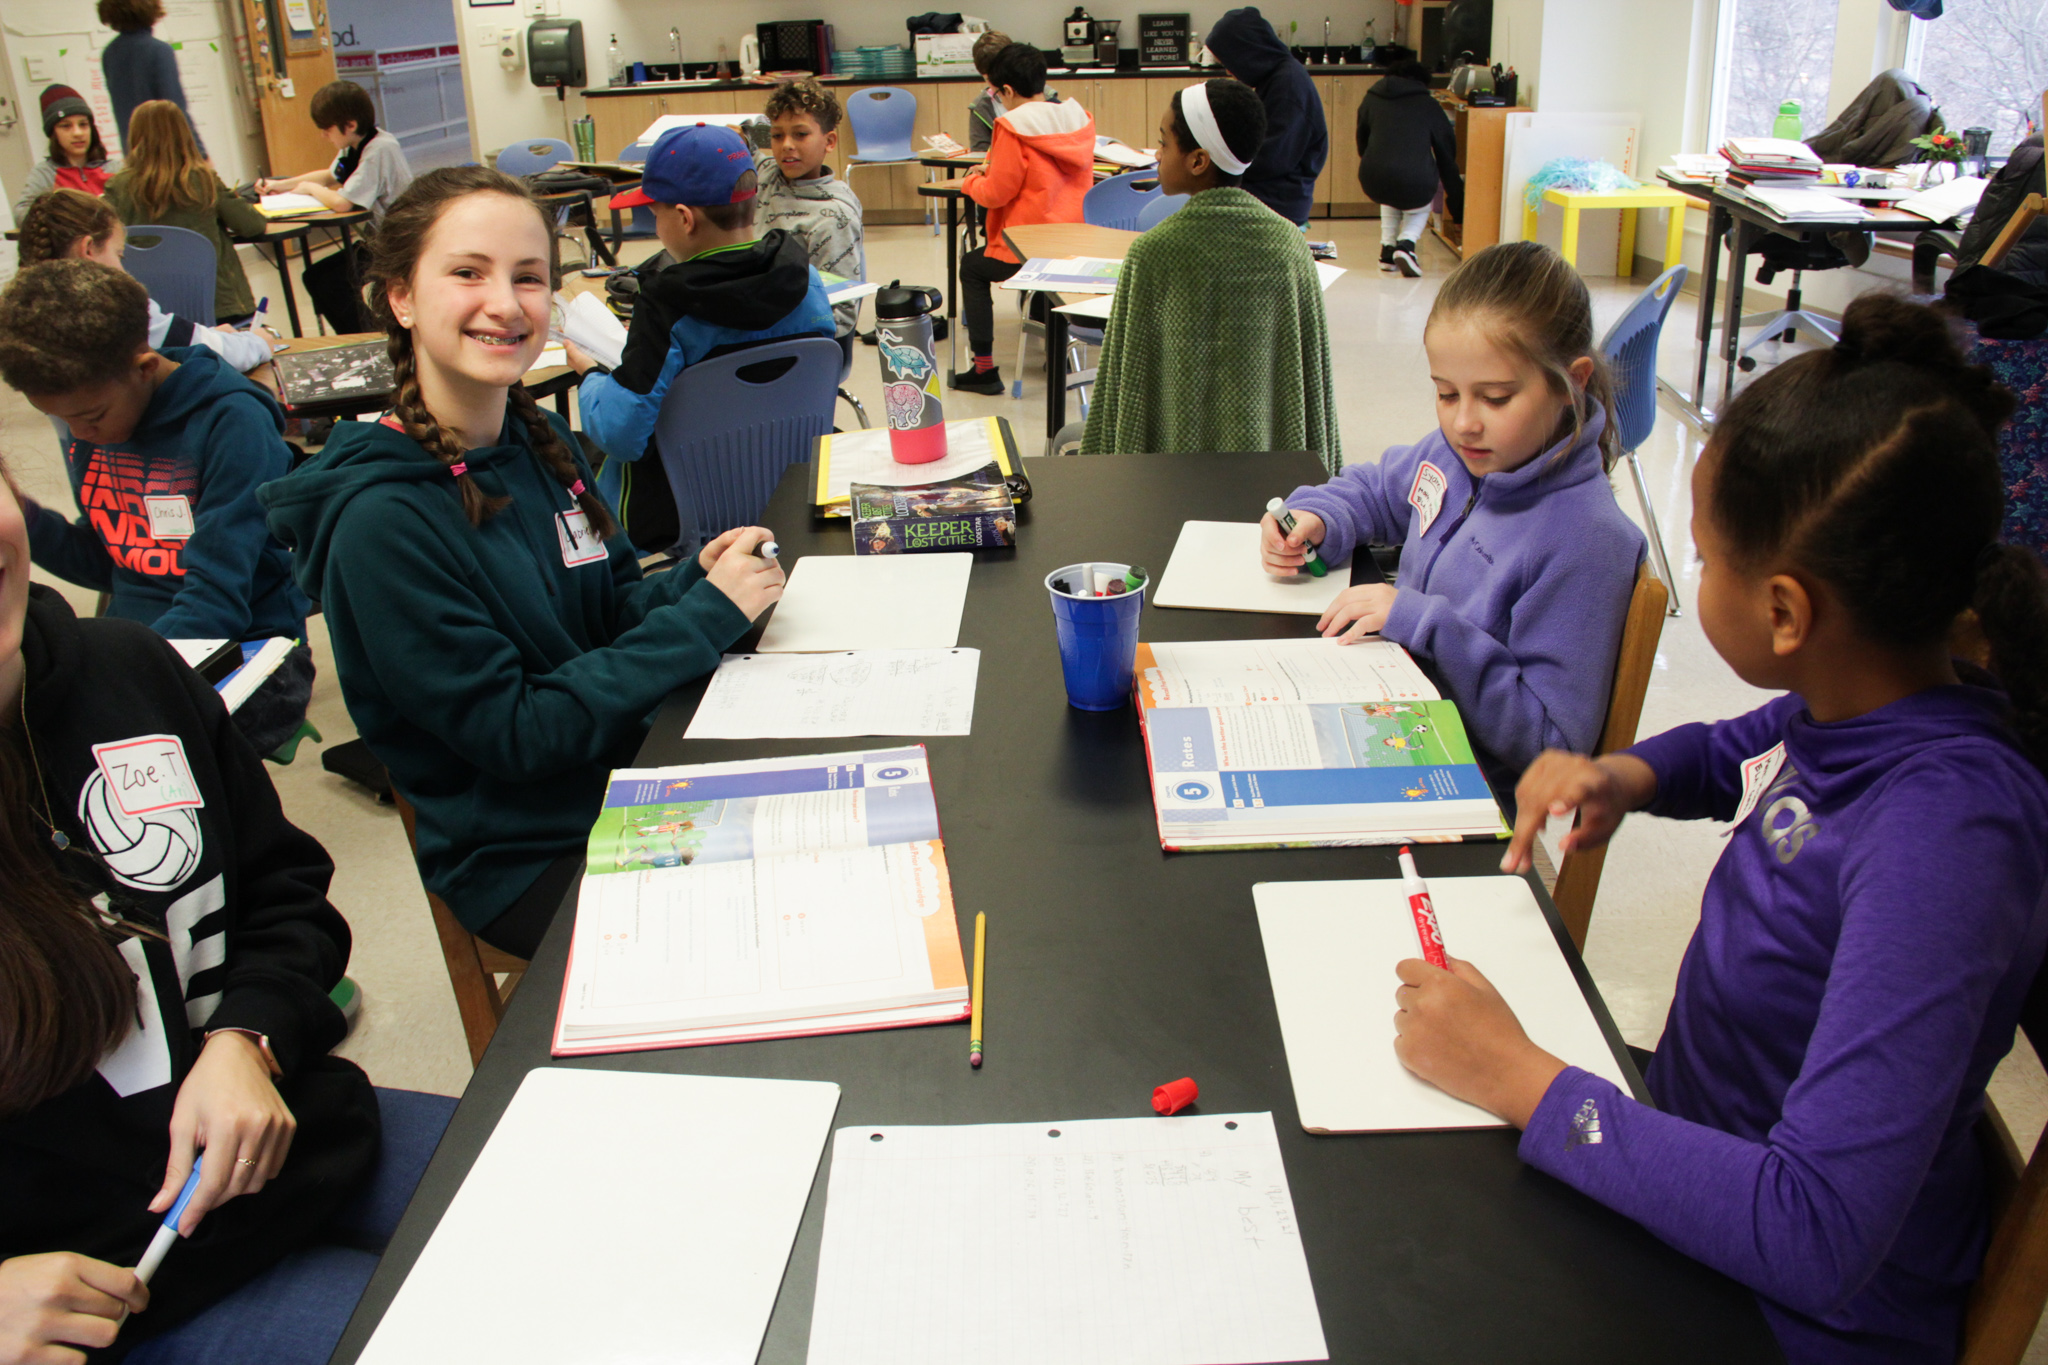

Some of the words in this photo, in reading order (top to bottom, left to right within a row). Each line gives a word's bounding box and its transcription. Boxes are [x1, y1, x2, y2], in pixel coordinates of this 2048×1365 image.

[1151, 53, 1180, 61] BEFORE!
[904, 520, 974, 539] KEEPER
[905, 536, 937, 549] LOST
[938, 534, 976, 547] CITIES
[975, 516, 983, 546] LODESTAR
[1182, 736, 1196, 768] Rates
[1183, 787, 1202, 796] 5
[912, 867, 927, 908] Knowledge
[1417, 896, 1445, 946] EXPO
[1228, 1170, 1253, 1188] My
[1238, 1206, 1264, 1251] best
